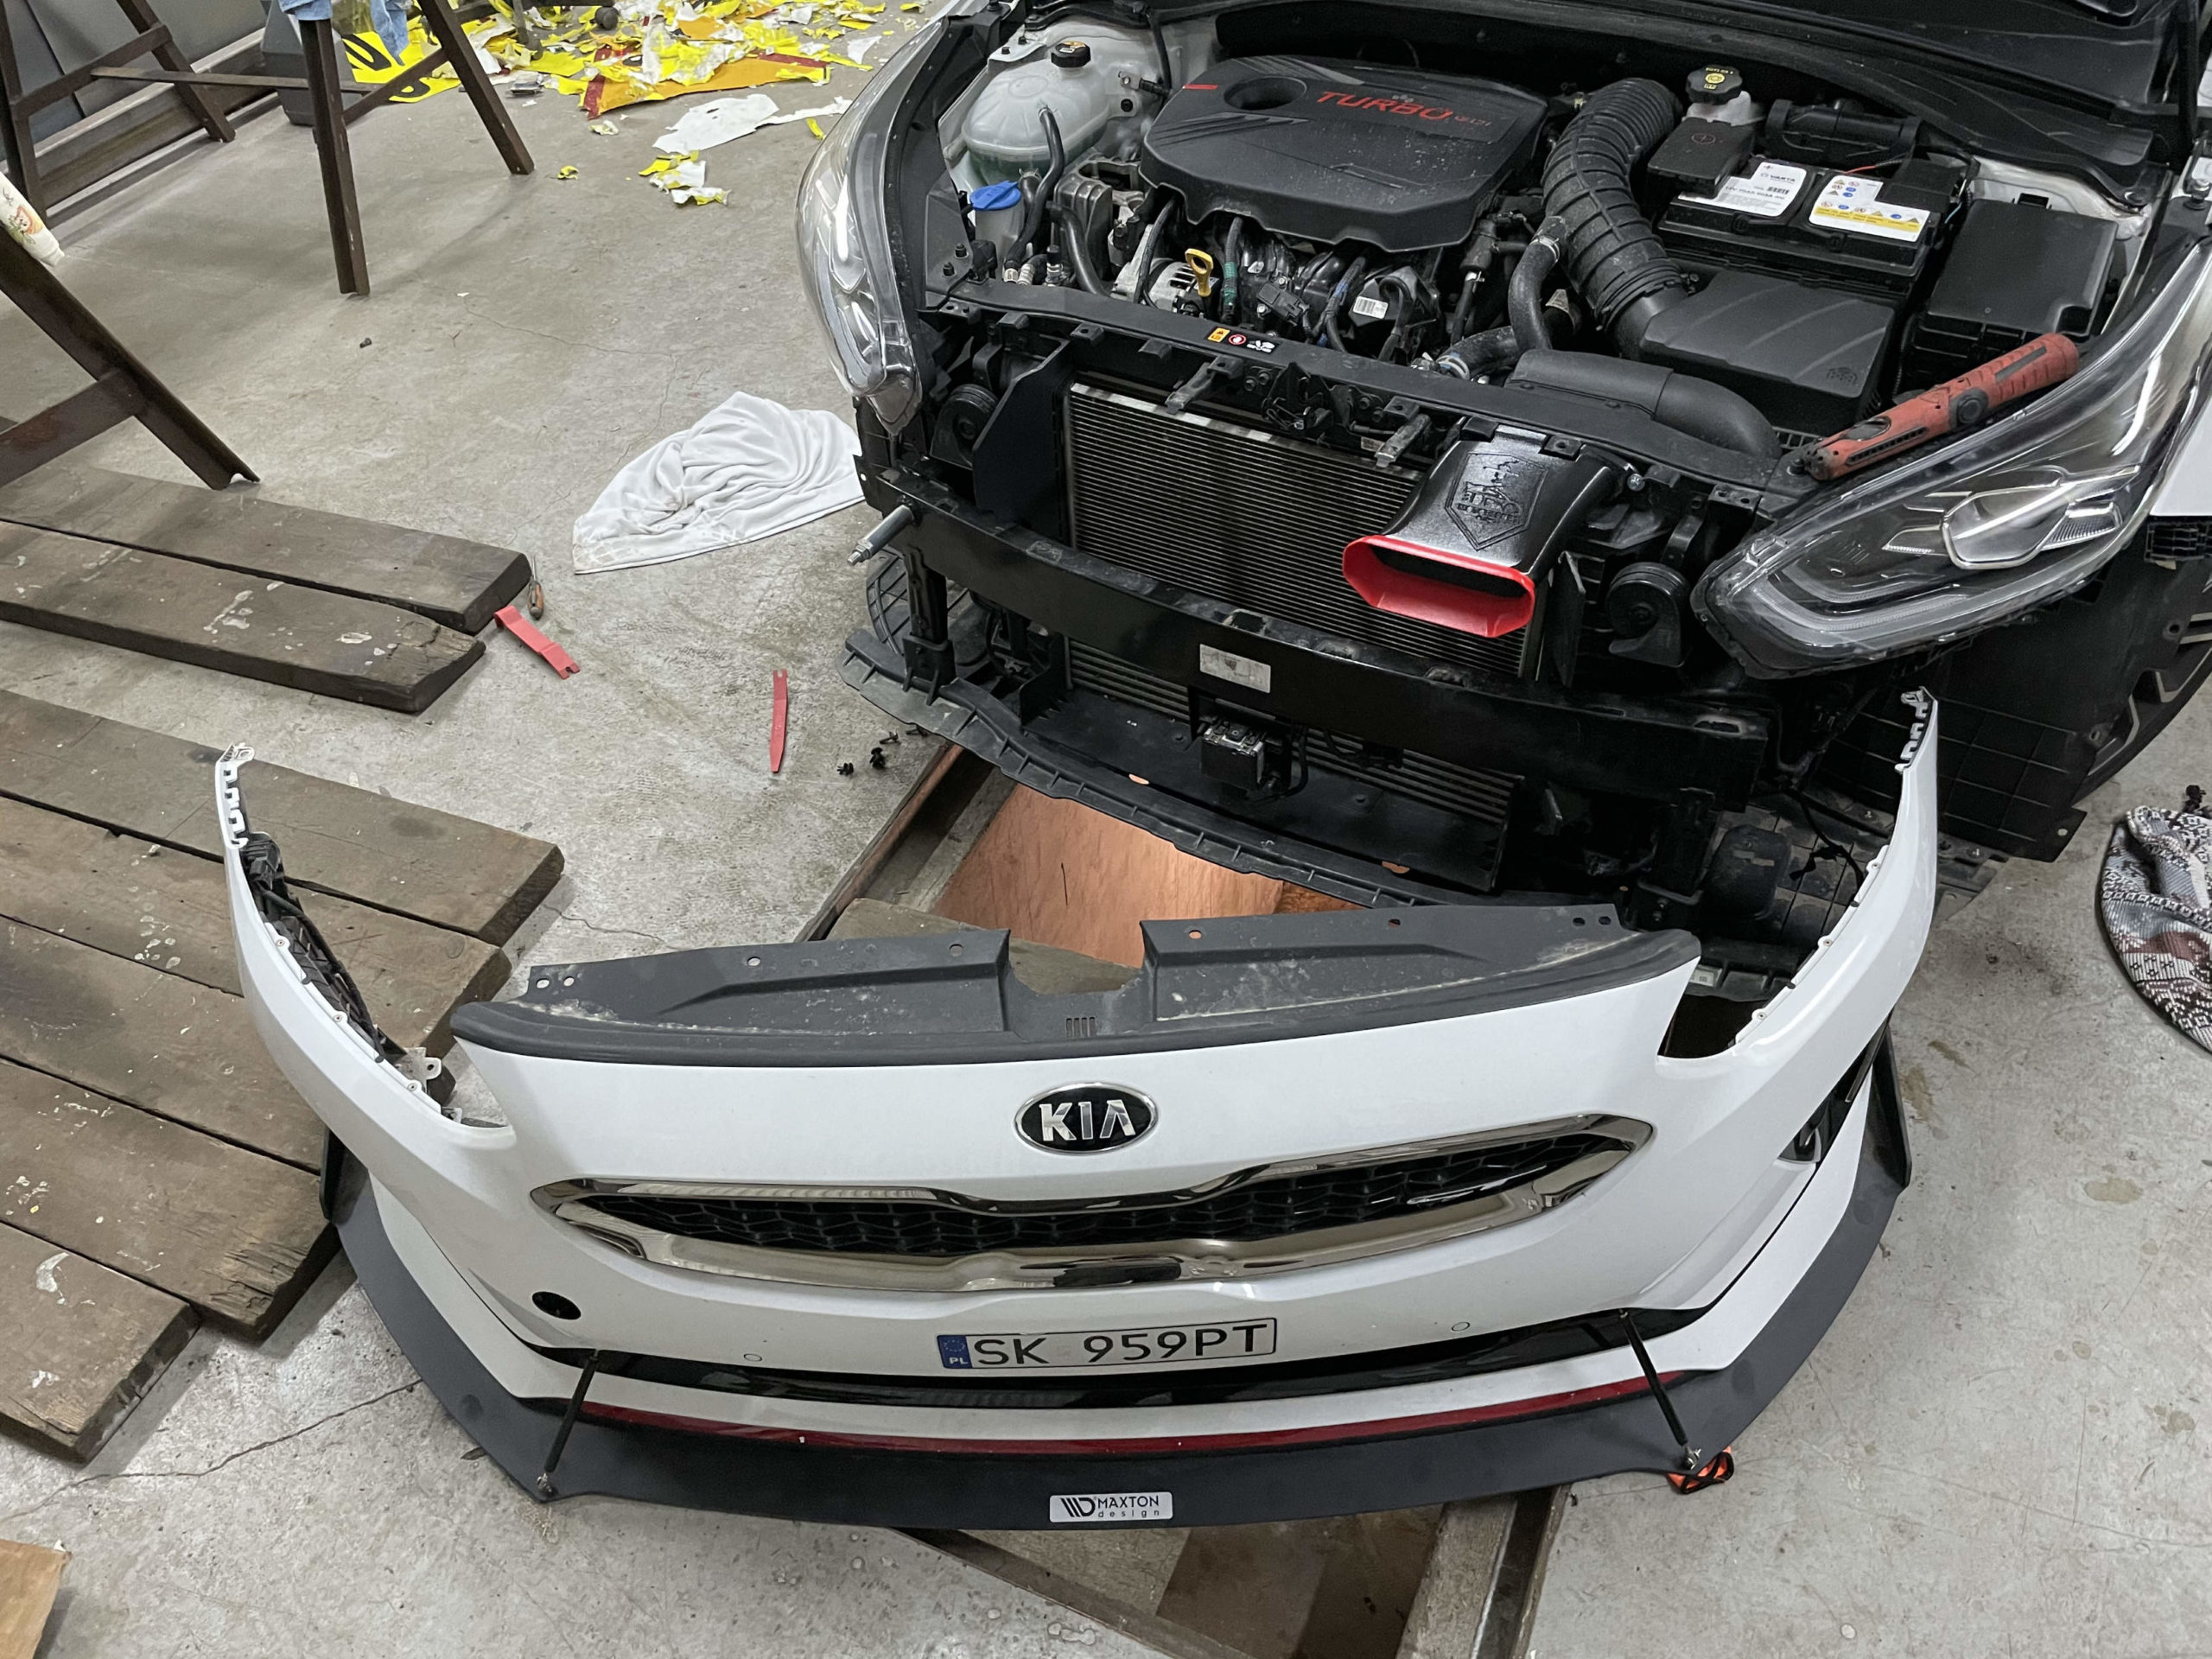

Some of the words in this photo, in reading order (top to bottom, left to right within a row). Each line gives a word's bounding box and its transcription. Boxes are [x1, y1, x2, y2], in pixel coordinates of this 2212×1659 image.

[1317, 91, 1453, 120] TURBO
[1039, 1099, 1136, 1141] KIA
[974, 1338, 1049, 1365] SK
[1084, 1324, 1268, 1363] 959PT
[950, 1357, 969, 1365] PL
[1097, 1495, 1160, 1509] MAXTON
[1098, 1509, 1160, 1518] design
